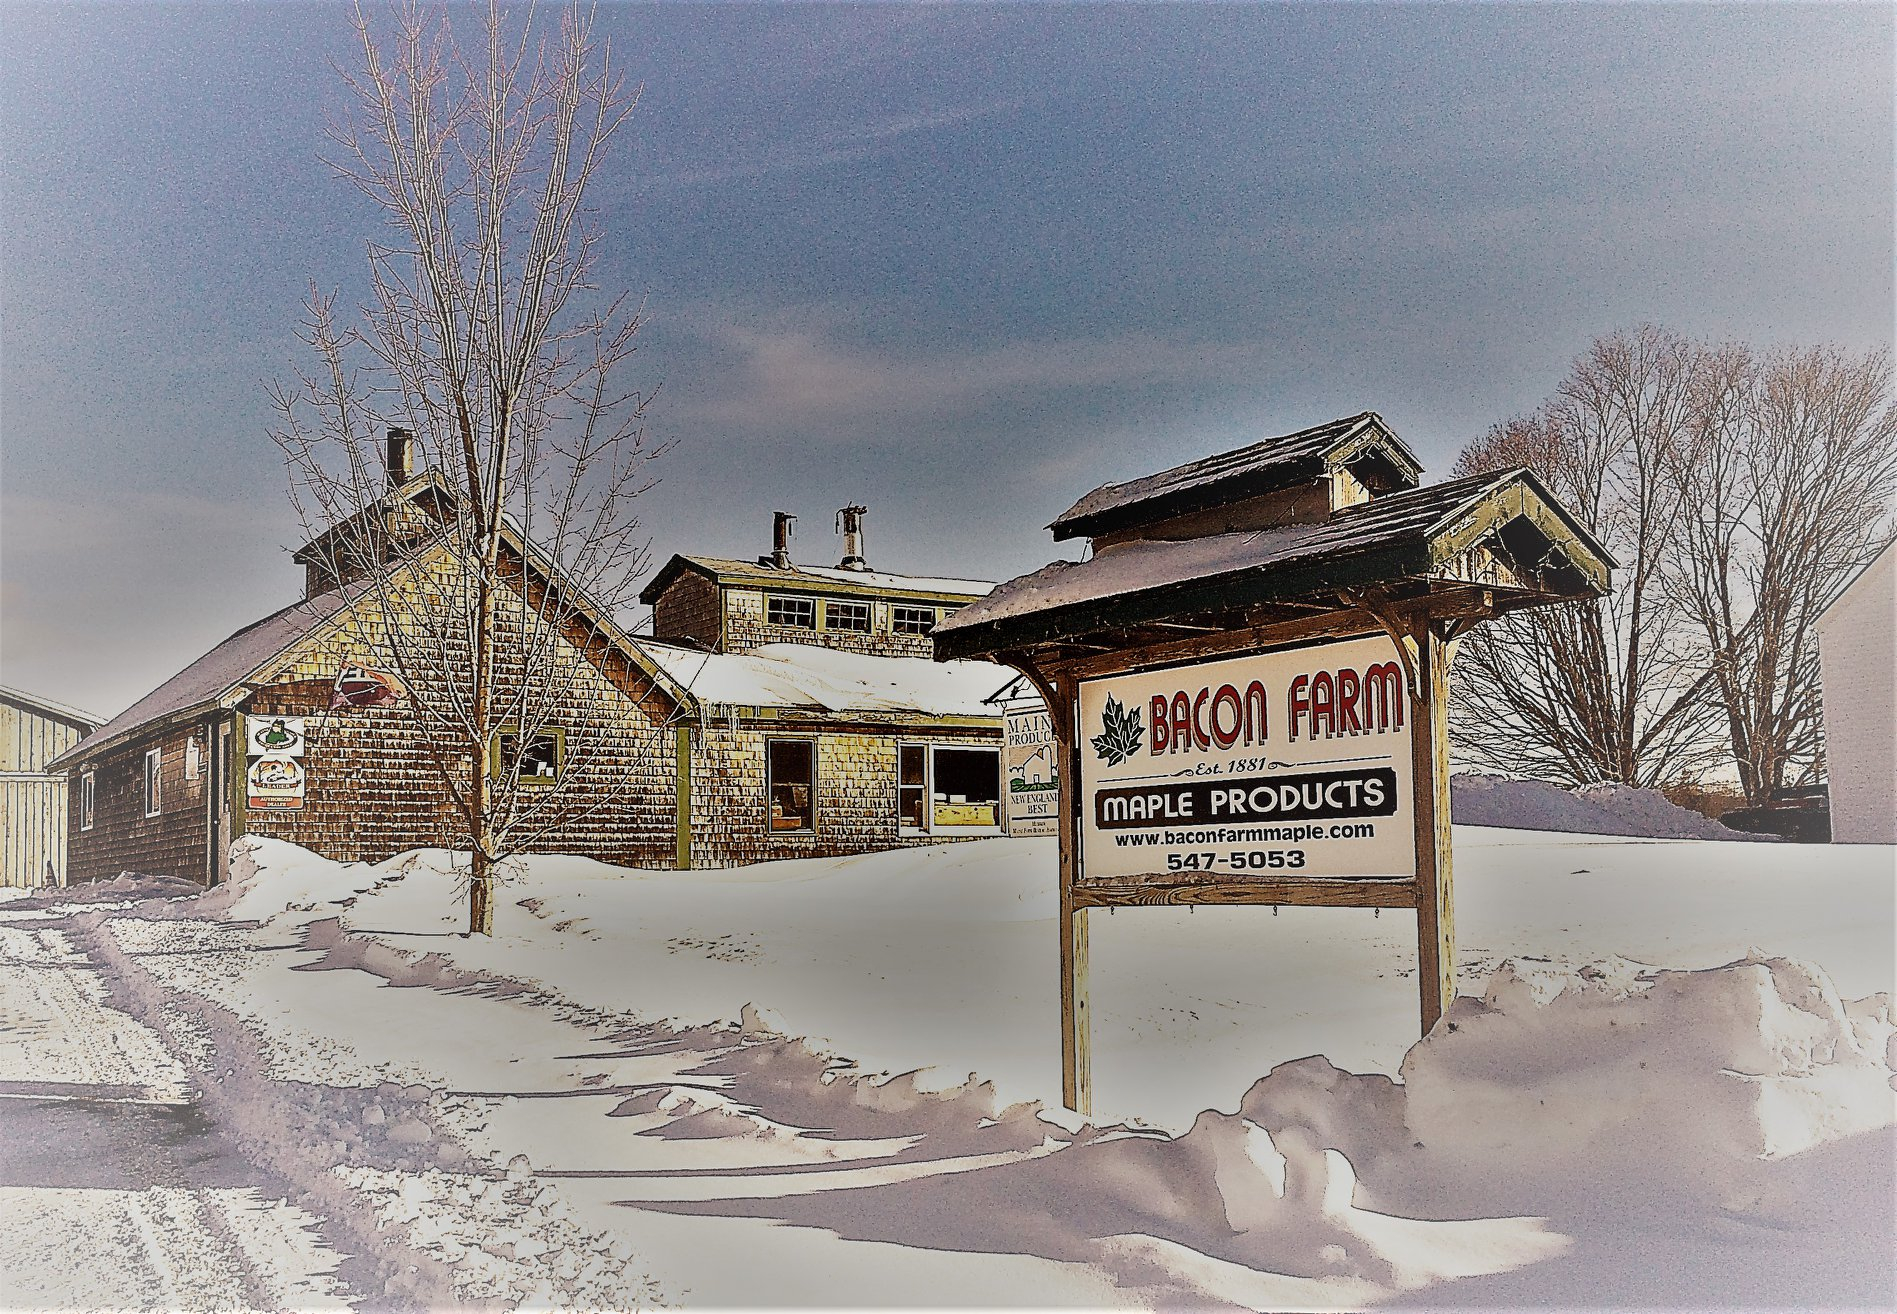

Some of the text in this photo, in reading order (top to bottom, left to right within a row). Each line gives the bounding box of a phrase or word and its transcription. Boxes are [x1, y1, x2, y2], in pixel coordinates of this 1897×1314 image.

[1149, 661, 1404, 757] BACON FARM
[1008, 714, 1052, 734] MAIN
[1009, 730, 1055, 746] PRODUC
[1195, 757, 1266, 777] Est. 1881
[1011, 794, 1026, 804] NEW
[1028, 803, 1048, 814] BEST
[1103, 778, 1385, 822] MAPLE PRODUCTS
[1115, 823, 1375, 847] www.baconfarmmaple.com
[1167, 850, 1306, 870] 547-5053
